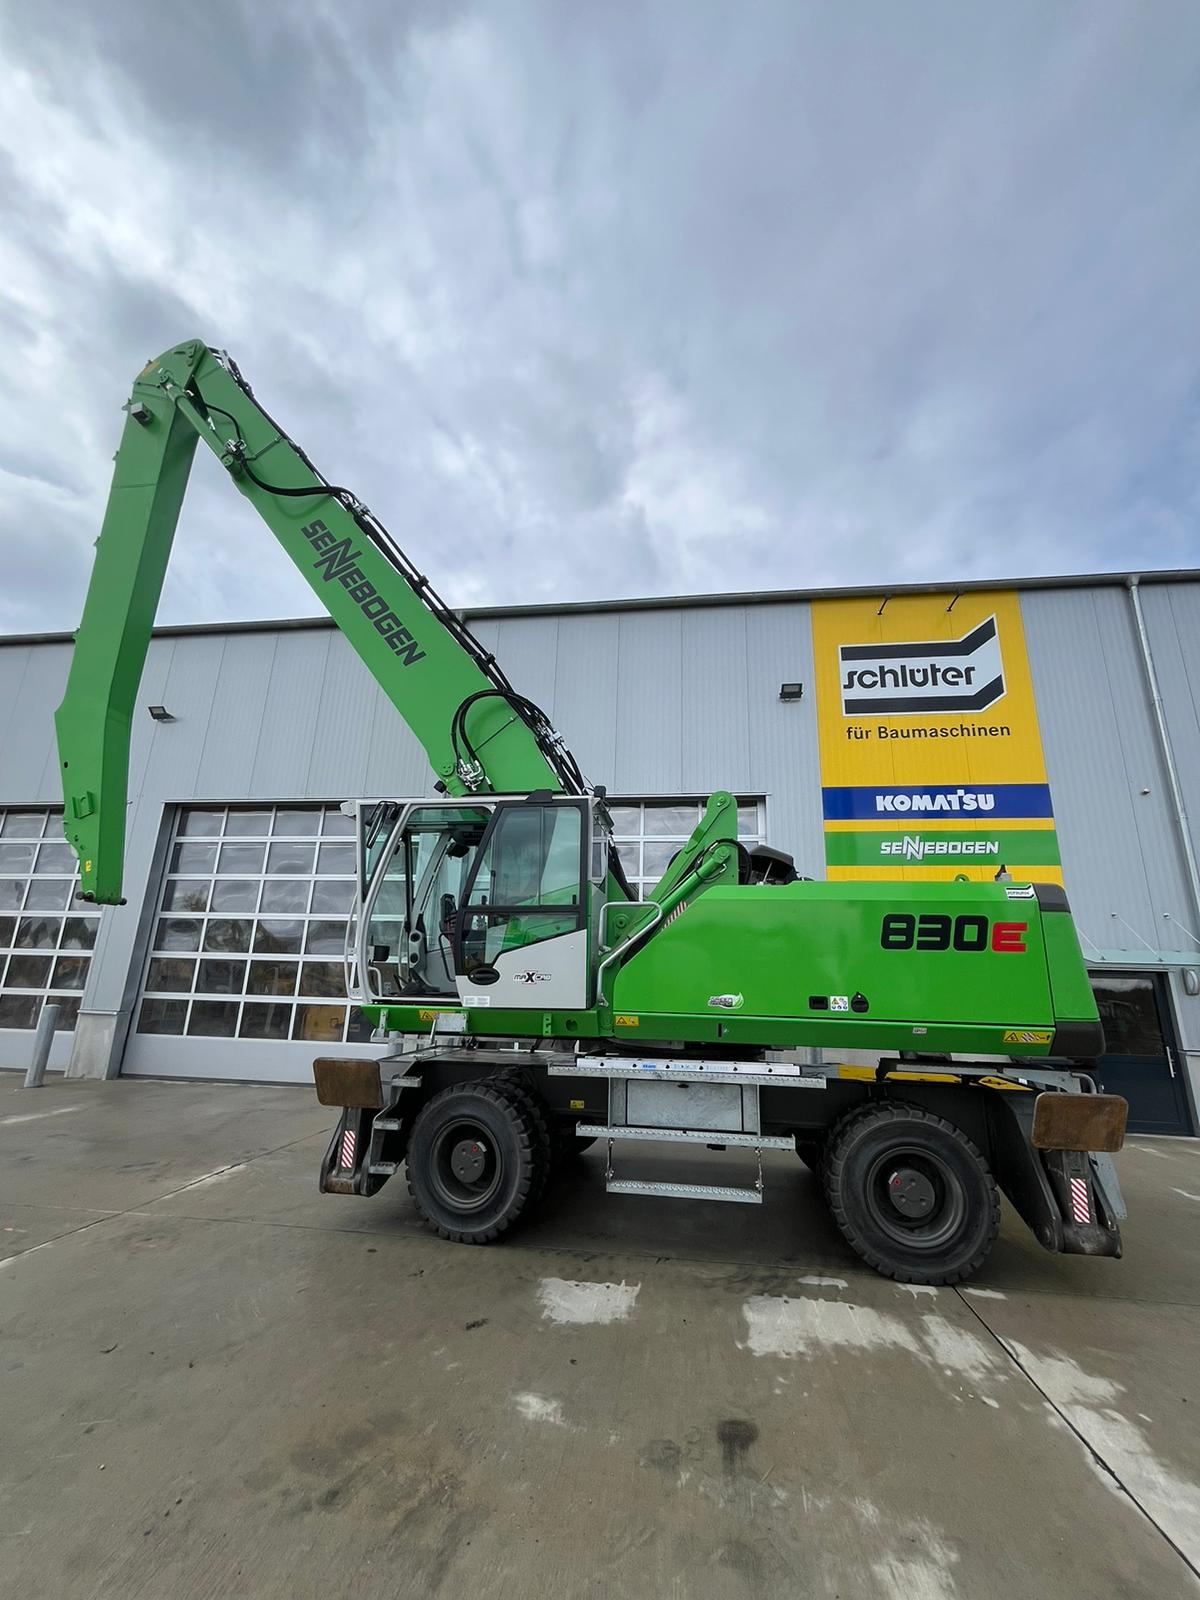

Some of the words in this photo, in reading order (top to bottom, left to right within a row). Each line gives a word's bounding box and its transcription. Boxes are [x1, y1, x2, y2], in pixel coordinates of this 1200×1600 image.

[301, 519, 427, 667] SENNEBOGEN
[843, 664, 975, 689] schlüter
[847, 727, 871, 739] für
[878, 724, 1011, 739] Baumaschinen
[876, 789, 995, 811] KOMATSU
[880, 836, 999, 860] SENNEBOGEN
[881, 914, 1028, 952] 830E
